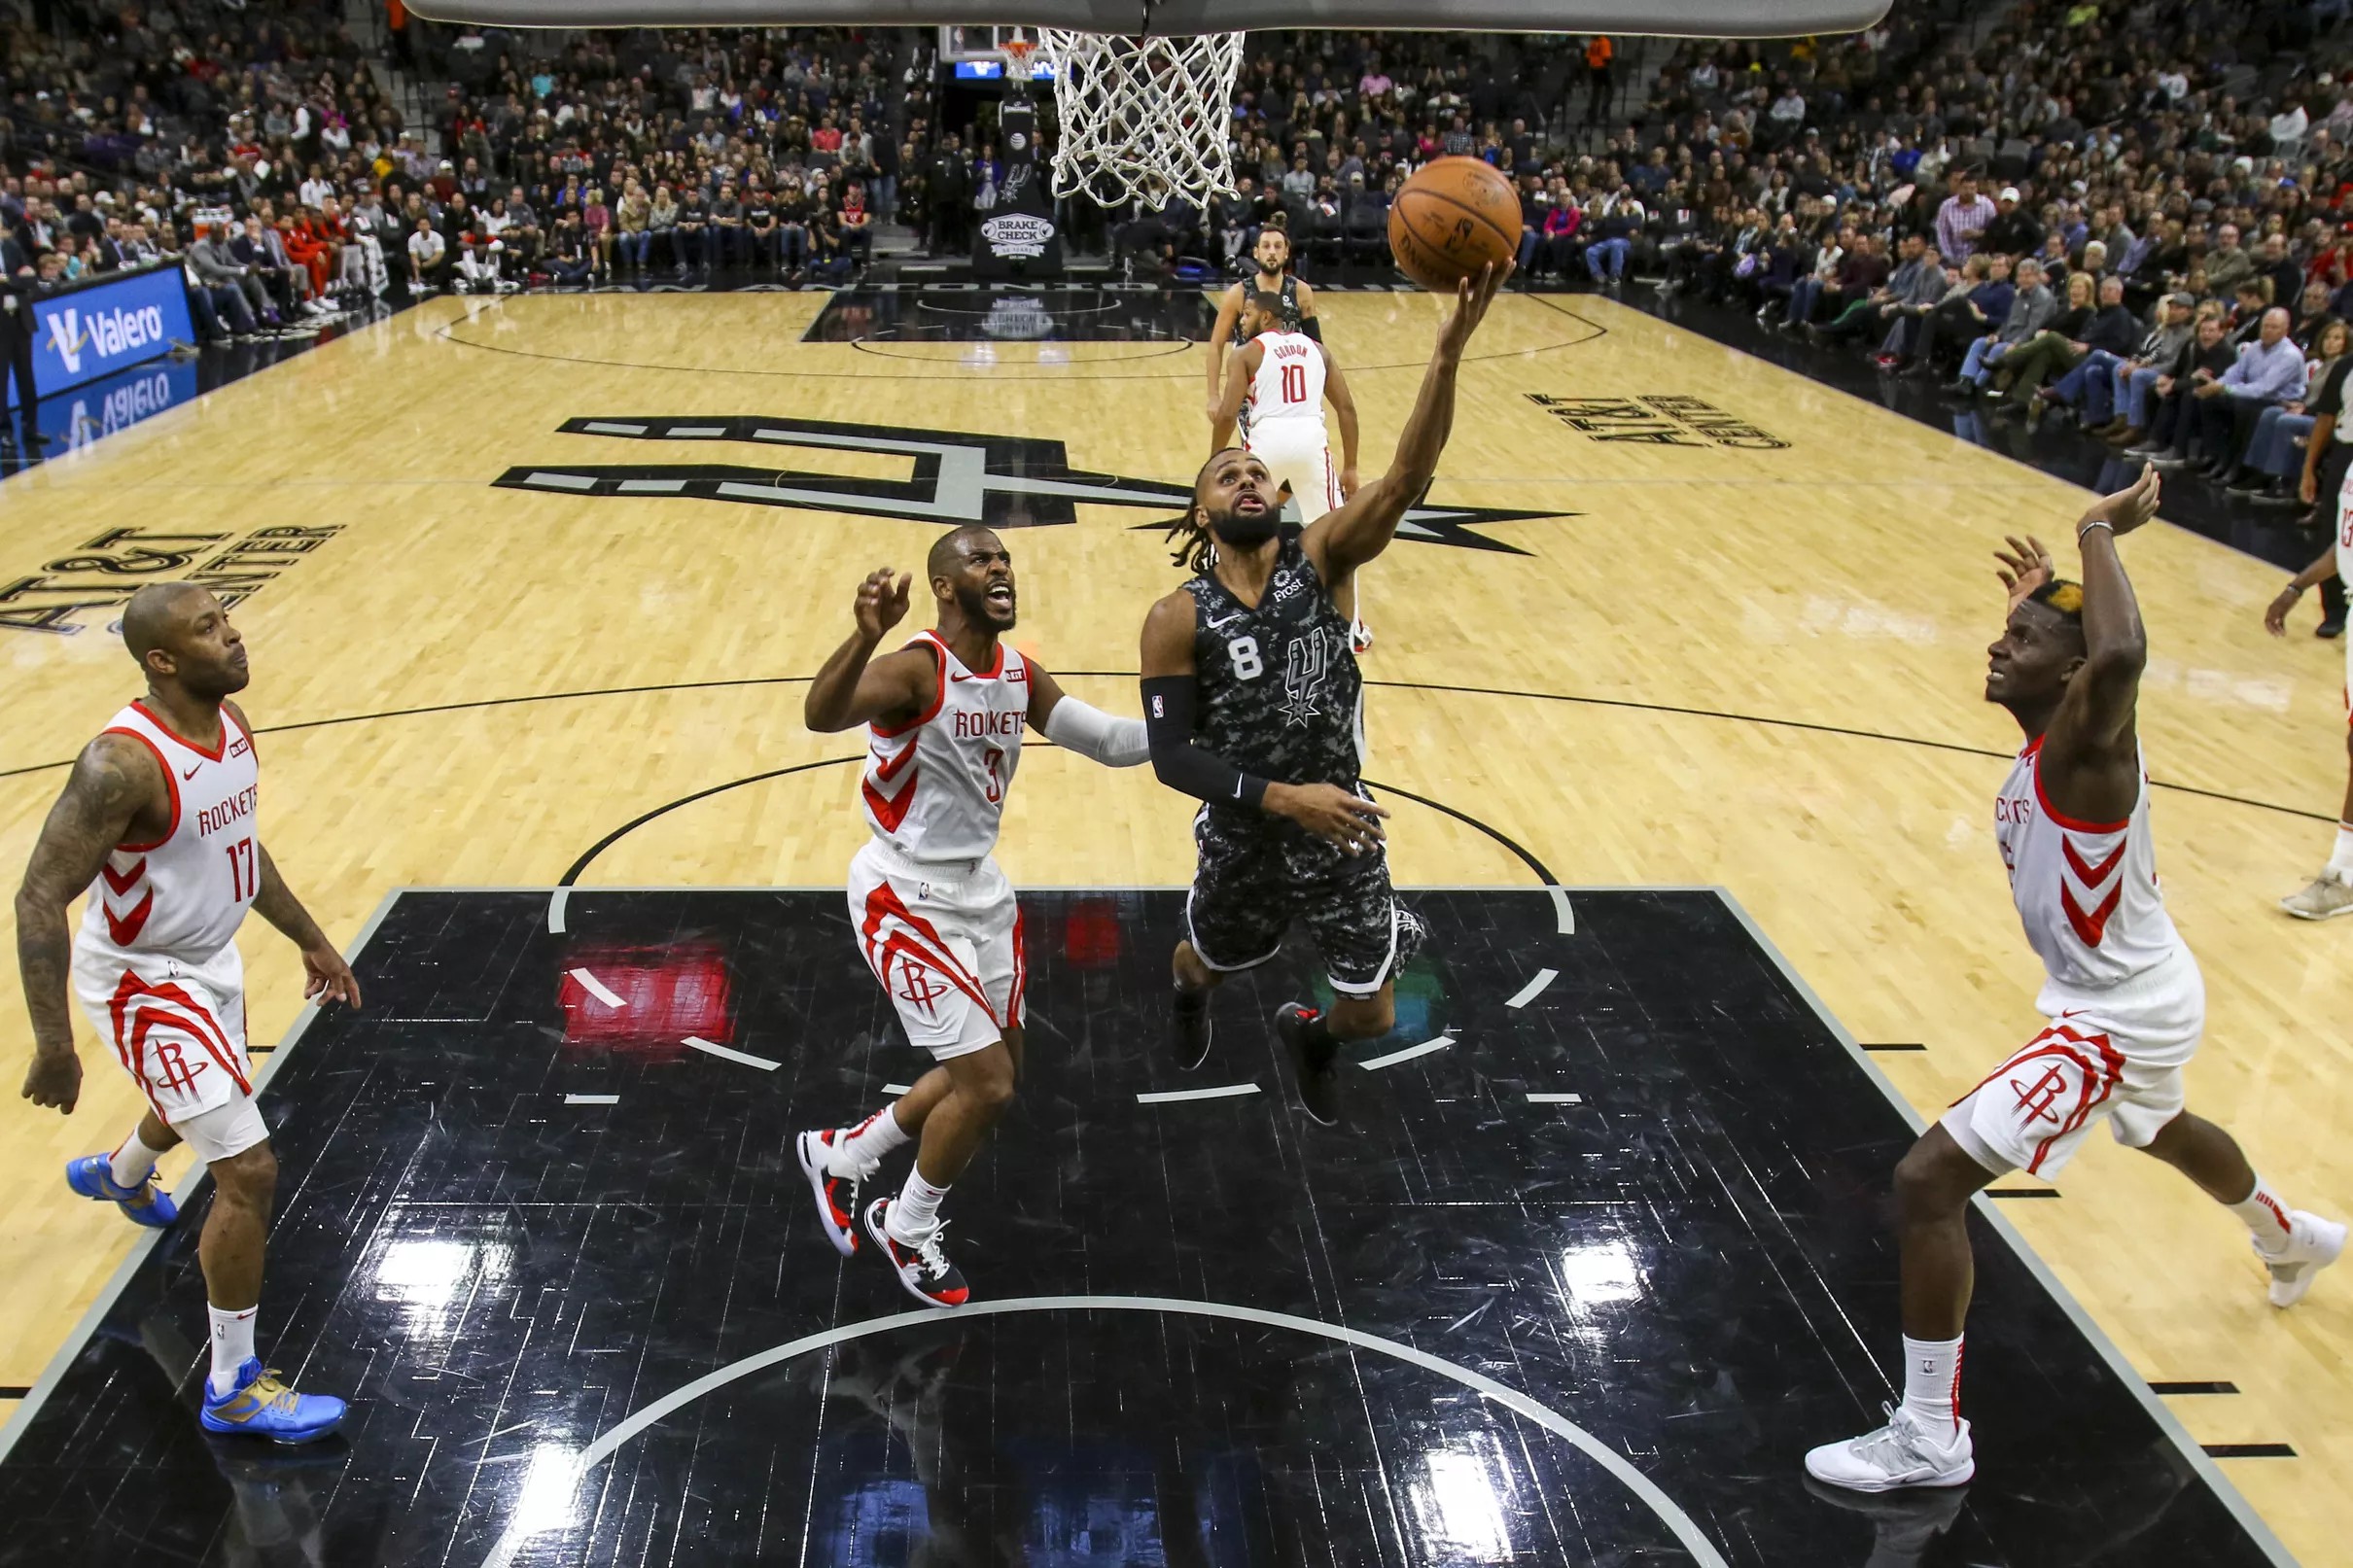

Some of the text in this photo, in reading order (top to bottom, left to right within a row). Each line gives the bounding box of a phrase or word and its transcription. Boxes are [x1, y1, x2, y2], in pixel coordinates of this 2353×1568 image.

[998, 221, 1038, 229] BRAKE
[998, 230, 1037, 240] CHECK
[85, 304, 163, 358] Valero
[1273, 344, 1308, 360] GORDON
[1281, 365, 1307, 403] 10
[1523, 393, 1713, 448] AT&T
[0, 526, 234, 635] AT&T
[1273, 577, 1304, 603] Frost
[1227, 635, 1264, 680] 8
[984, 748, 1004, 803] 3
[227, 836, 254, 903] 17
